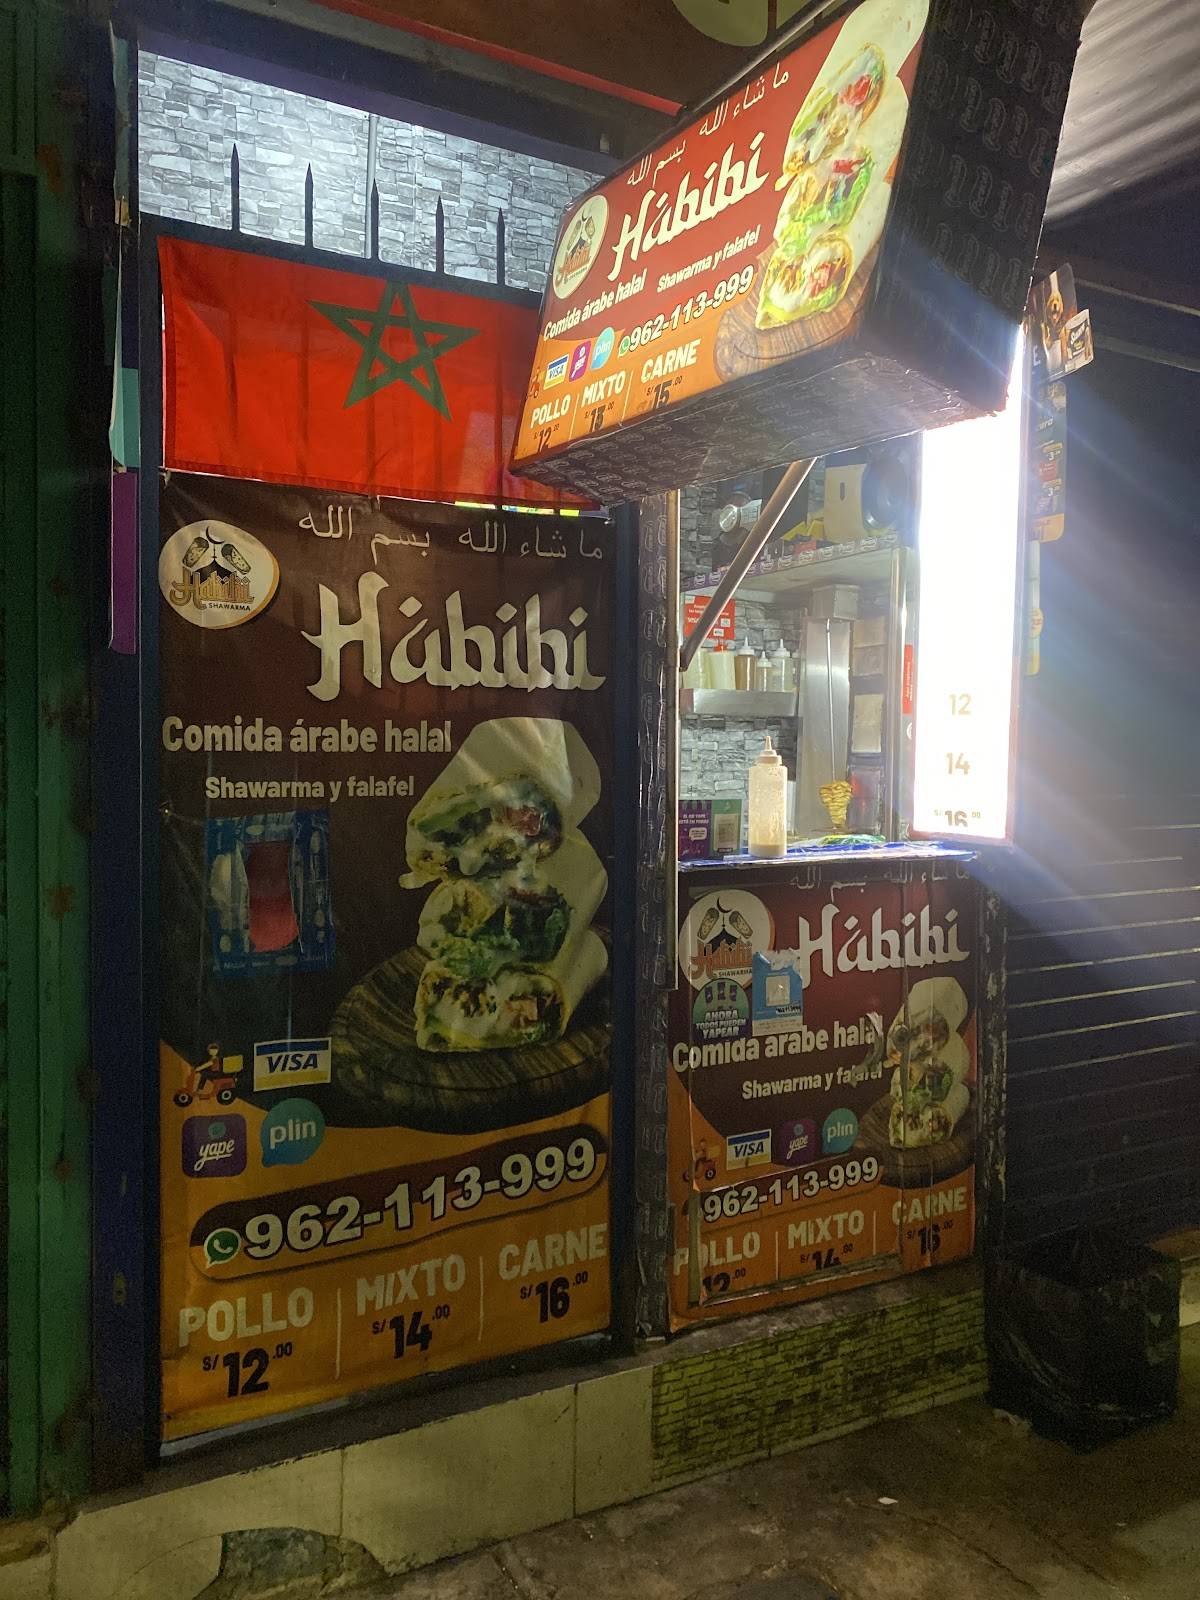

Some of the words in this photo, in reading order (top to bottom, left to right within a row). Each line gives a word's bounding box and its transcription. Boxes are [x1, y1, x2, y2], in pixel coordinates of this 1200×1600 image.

[657, 255, 713, 293] Shawarma
[721, 224, 761, 261] falafel
[543, 307, 582, 341] Comida
[581, 291, 615, 322] árabe
[615, 268, 648, 304] halal
[629, 264, 754, 351] 962-113-999
[549, 365, 565, 380] VISA
[641, 338, 701, 383] CARNE
[581, 370, 626, 407] MIXTO
[530, 394, 572, 428] POLLO
[949, 693, 972, 716] 12
[162, 715, 280, 753] Comida
[289, 718, 378, 753] árabe
[384, 719, 452, 753] halal
[946, 752, 971, 775] 14
[205, 775, 326, 800] Shawarma
[329, 780, 342, 803] y
[347, 775, 415, 798] falafel
[702, 1026, 740, 1039] YAPEAR
[704, 1008, 739, 1022] AHORA
[266, 1051, 318, 1074] VISA
[673, 1037, 760, 1073] Comida
[742, 1072, 822, 1100] Shawarma
[824, 1072, 834, 1091] y
[269, 1116, 316, 1148] plin
[733, 1139, 765, 1158] VISA
[827, 1121, 853, 1143] plin
[193, 1138, 235, 1172] yape
[243, 1136, 597, 1258] 962-113-999
[703, 1156, 879, 1223] 962-113-999
[891, 1186, 968, 1226] CARNE
[787, 1210, 865, 1250] MIXTO
[498, 1222, 608, 1281] CARNE
[356, 1253, 466, 1316] MIXTO
[178, 1286, 314, 1347] POLLO
